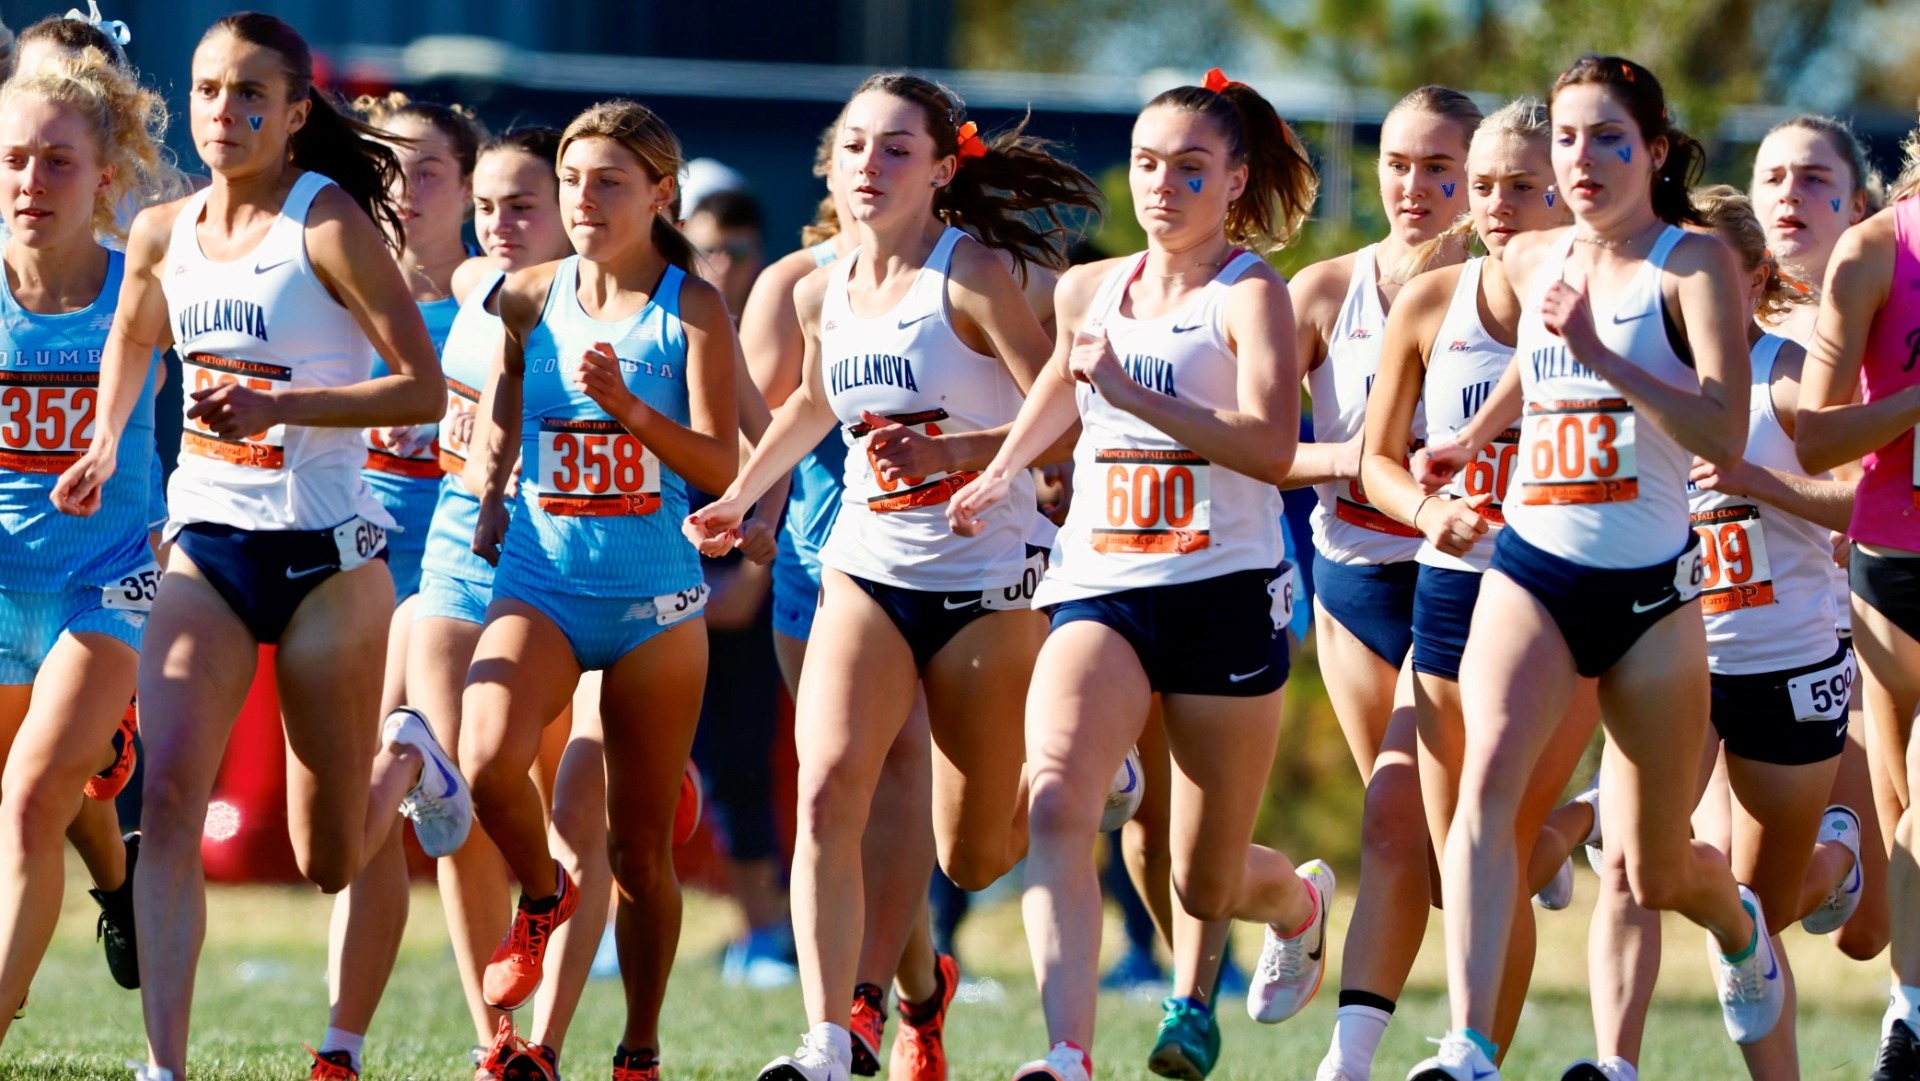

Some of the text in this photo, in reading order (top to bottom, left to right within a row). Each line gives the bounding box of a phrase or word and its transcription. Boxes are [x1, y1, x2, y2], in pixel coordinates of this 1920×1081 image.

[179, 299, 268, 343] VILLANOVA
[50, 373, 70, 381] FALL
[532, 358, 673, 379] COLBIA
[831, 354, 918, 396] VILLANOVA
[2, 387, 97, 449] 352
[547, 419, 591, 428] PRINCETON
[593, 421, 611, 429] FALL
[1101, 450, 1144, 459] PRINCETON
[1145, 451, 1164, 459] FALL
[1532, 414, 1619, 479] 603
[553, 433, 645, 493] 358
[1106, 464, 1194, 528] 600
[120, 570, 162, 601] 35
[675, 585, 705, 611] 35
[1702, 593, 1736, 607] Carroll
